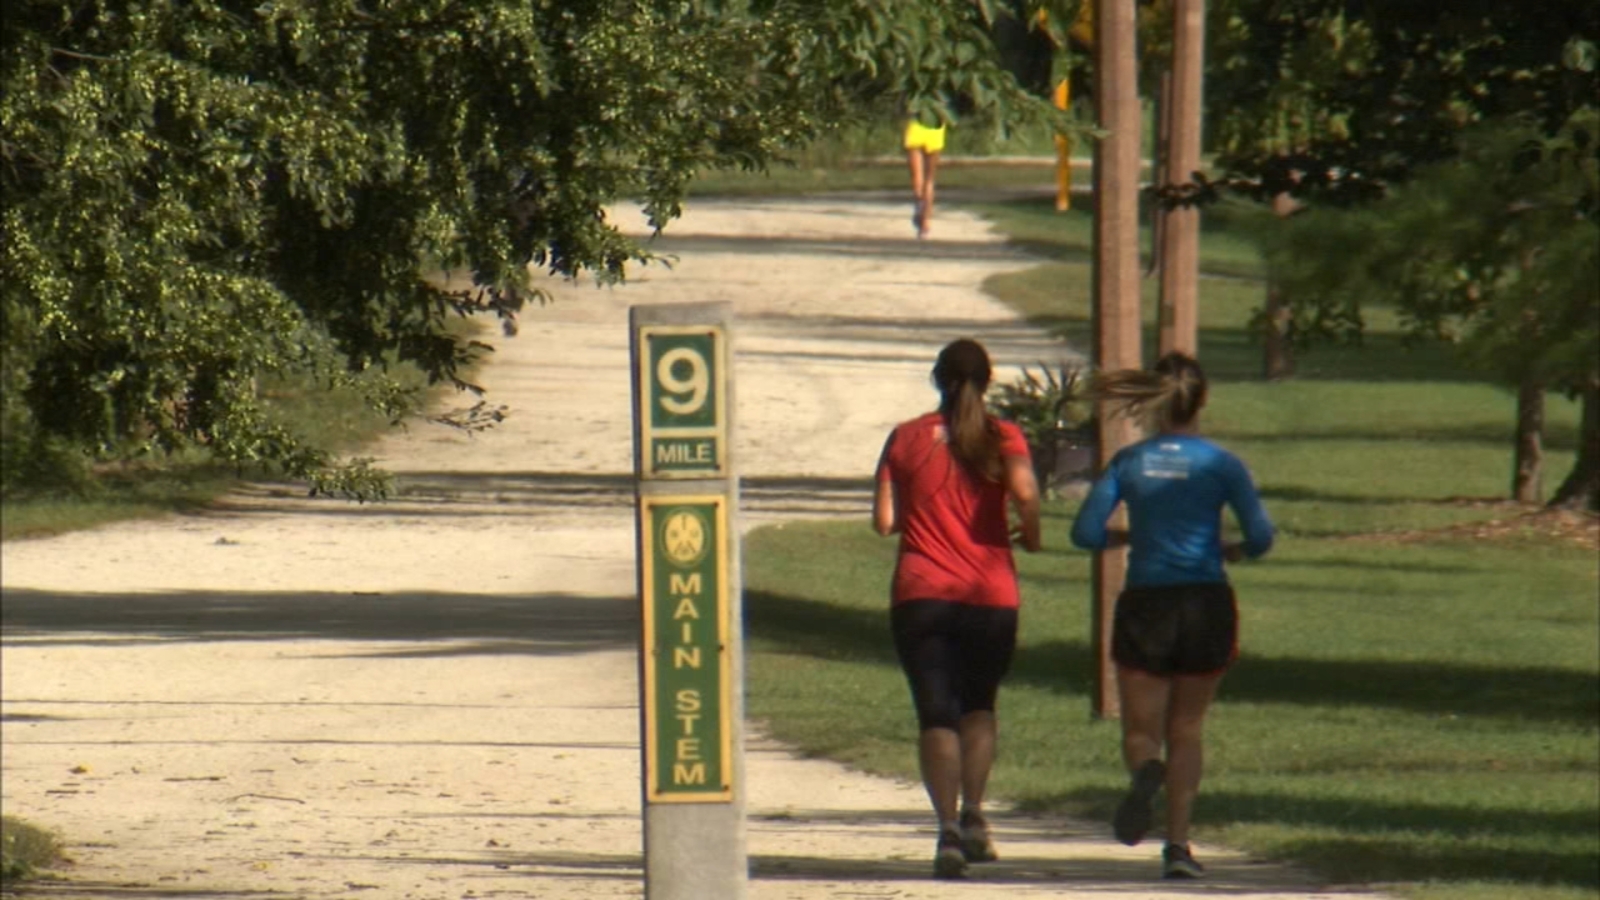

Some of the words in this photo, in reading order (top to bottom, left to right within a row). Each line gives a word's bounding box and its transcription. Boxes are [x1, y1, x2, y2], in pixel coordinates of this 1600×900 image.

[657, 347, 709, 414] 9
[656, 443, 711, 463] MILE
[669, 572, 702, 669] MAIN
[673, 689, 706, 785] STEM
